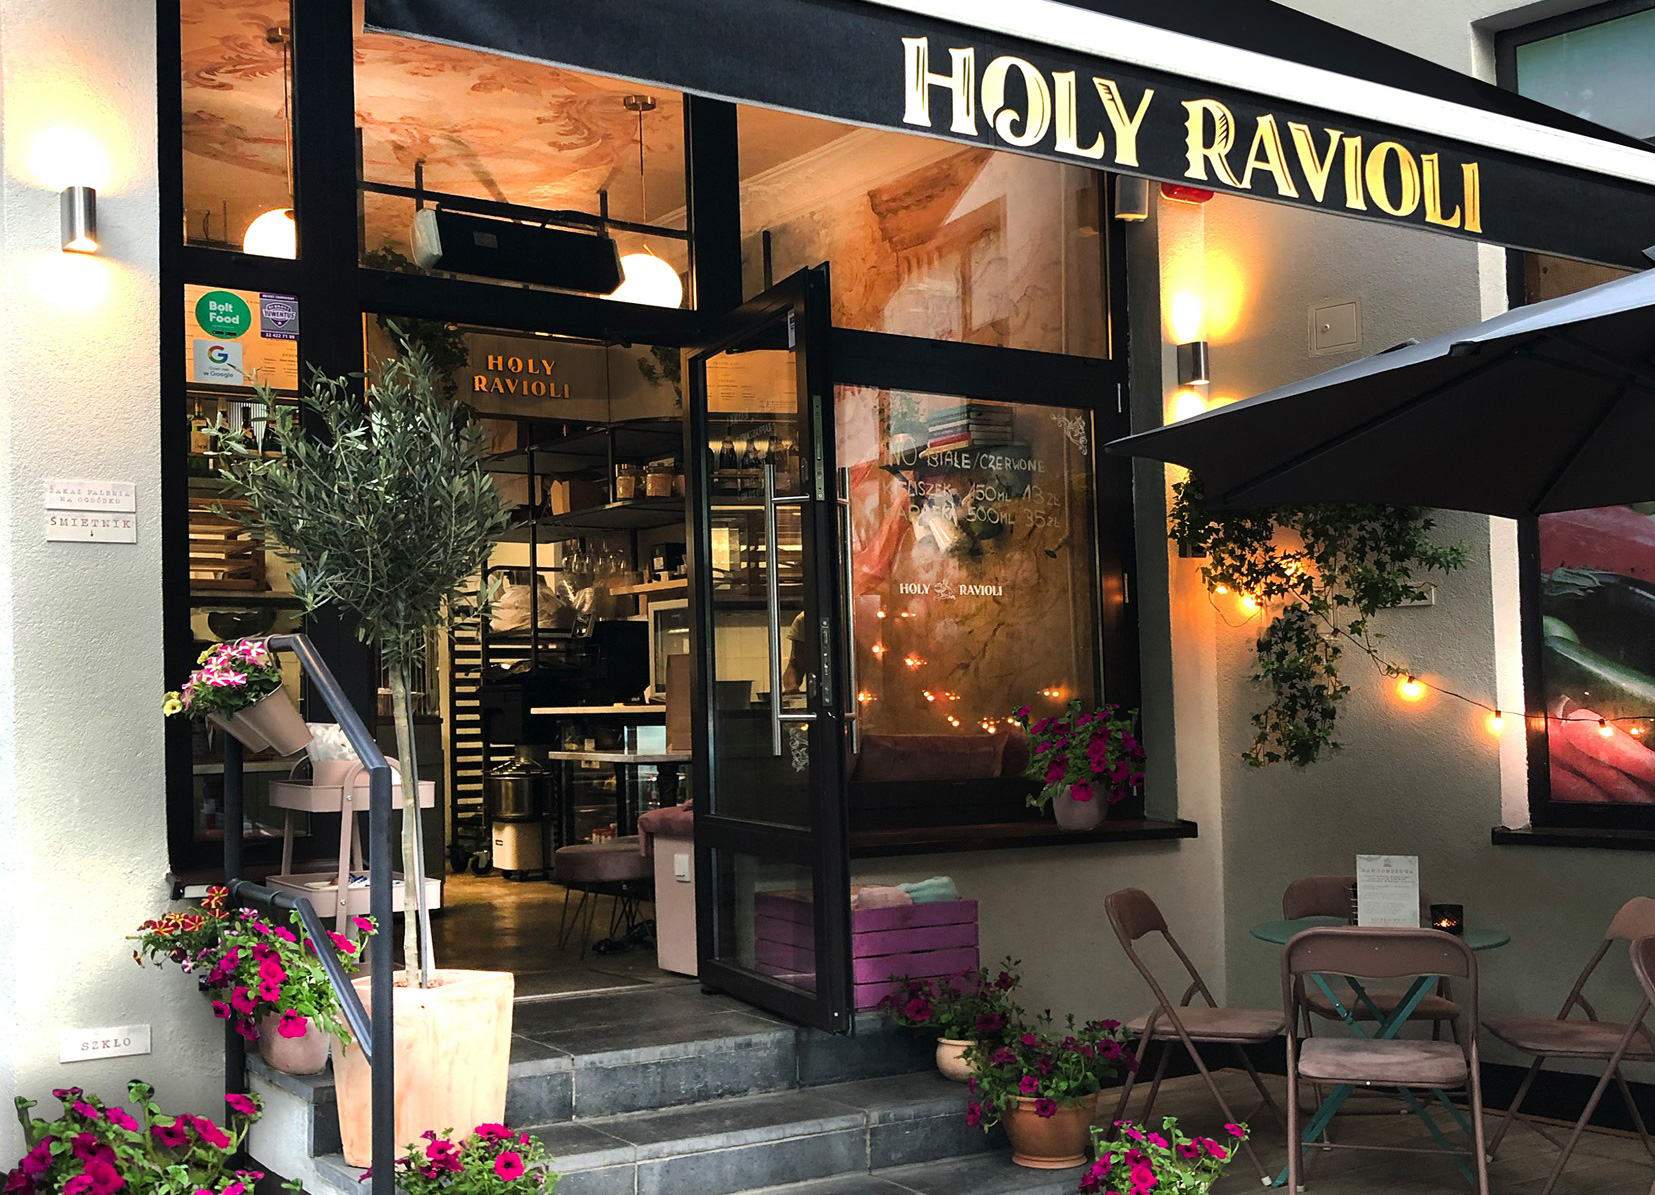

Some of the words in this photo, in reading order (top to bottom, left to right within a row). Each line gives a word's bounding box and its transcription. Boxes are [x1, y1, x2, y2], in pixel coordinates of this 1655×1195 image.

[902, 36, 1155, 168] HOLY
[1181, 98, 1483, 234] RAVIOLI
[208, 301, 233, 312] Bolt
[209, 312, 240, 325] Food
[486, 354, 556, 376] HOLY
[210, 370, 234, 378] Google
[472, 374, 571, 400] RAVIOLI
[87, 489, 130, 497] PALENIA
[77, 496, 121, 505] OGRÓDKU
[50, 516, 131, 529] ŚMIETNIK
[899, 582, 931, 595] HOLY
[959, 584, 1003, 597] RAVIOLI
